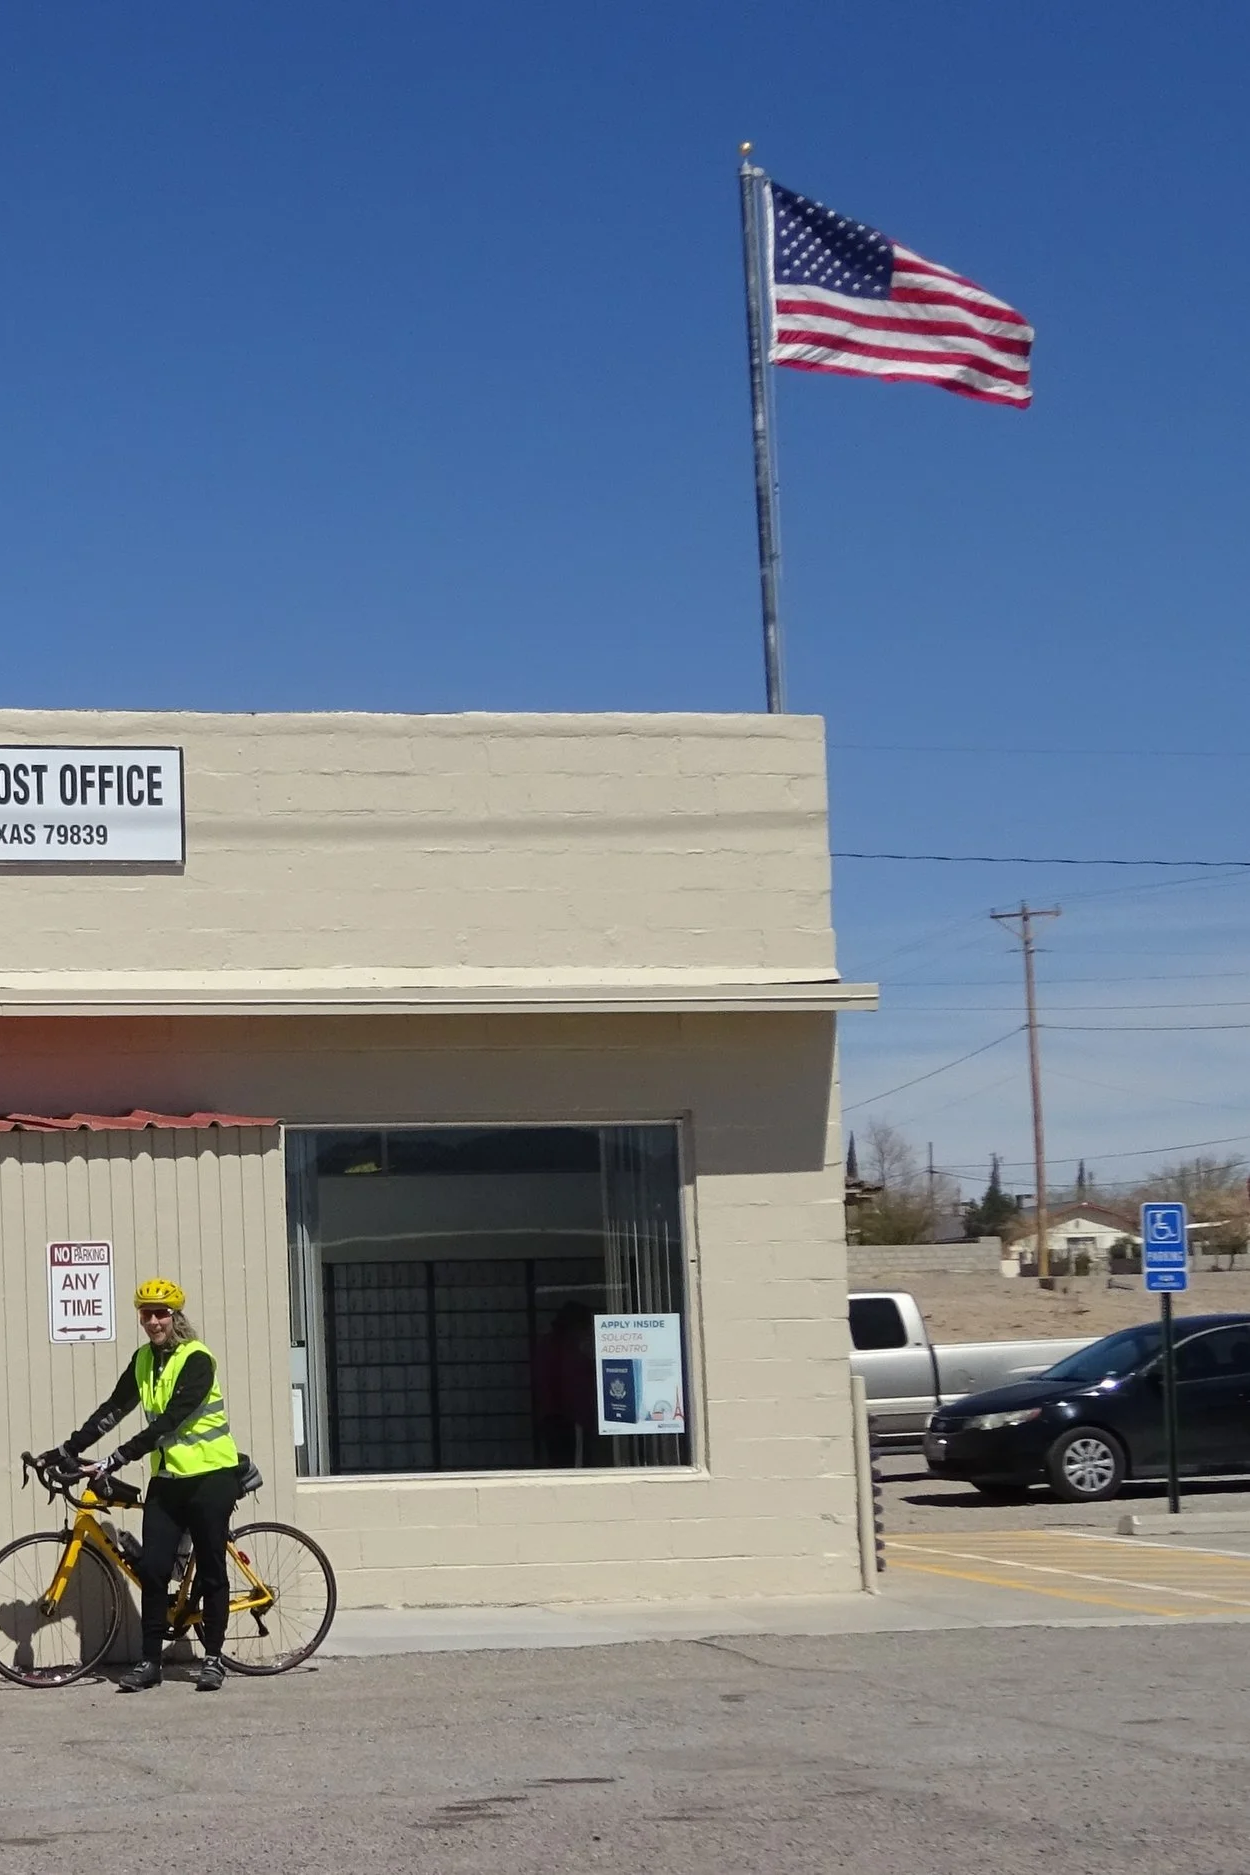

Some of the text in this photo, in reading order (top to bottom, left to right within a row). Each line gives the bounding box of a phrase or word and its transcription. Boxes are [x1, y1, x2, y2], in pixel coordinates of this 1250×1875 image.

[59, 764, 163, 807] OFFICE
[42, 824, 108, 845] 79839
[54, 1246, 105, 1263] NO PARKING
[61, 1273, 100, 1291] ANY
[60, 1299, 103, 1317] TIME
[600, 1320, 665, 1329] APPLY INSIDE
[600, 1333, 643, 1342] SOLICITA
[600, 1344, 648, 1353] ADENTRO
